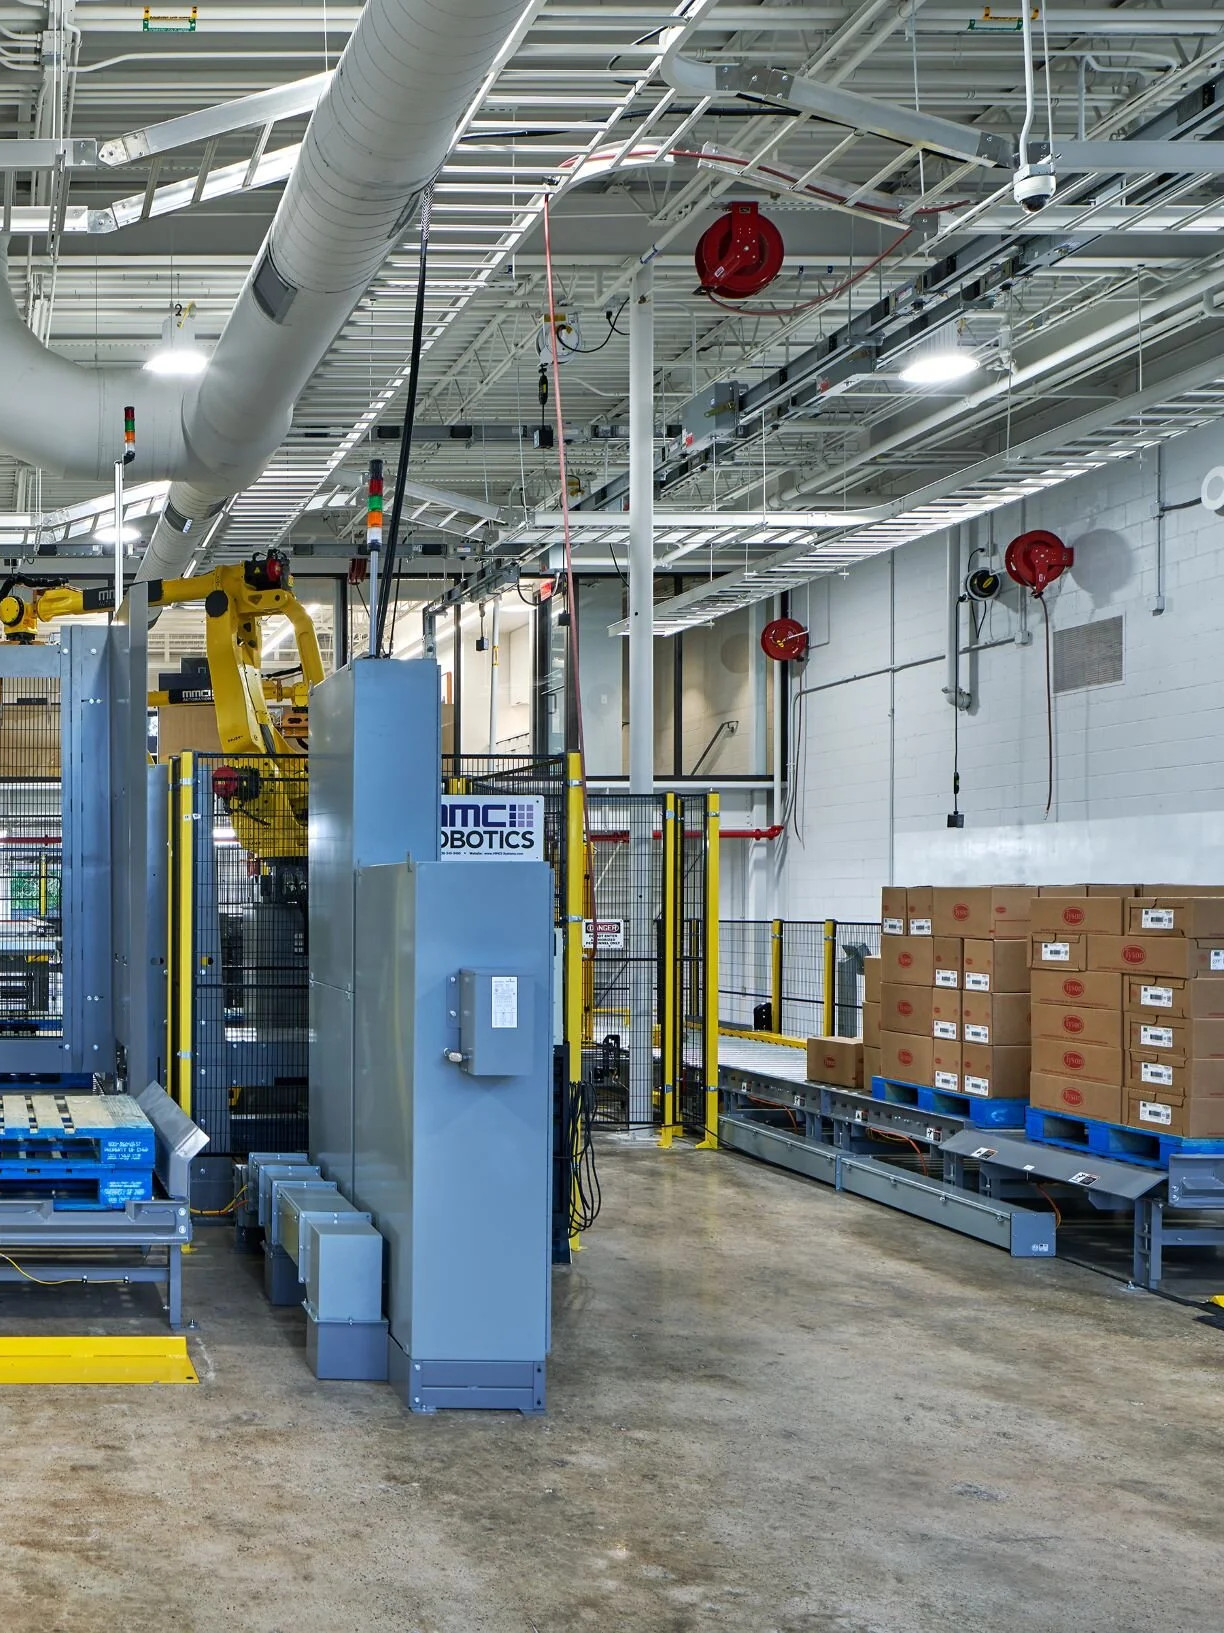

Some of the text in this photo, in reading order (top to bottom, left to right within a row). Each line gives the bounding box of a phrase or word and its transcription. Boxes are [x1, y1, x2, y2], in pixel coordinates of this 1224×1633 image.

[441, 830, 535, 849] BOTICS
[1064, 910, 1083, 921] Tyson
[1124, 948, 1144, 961] Tyson
[1064, 982, 1083, 993] Tyson
[1064, 1054, 1083, 1066] Tyson
[1063, 1090, 1081, 1101] Tyson
